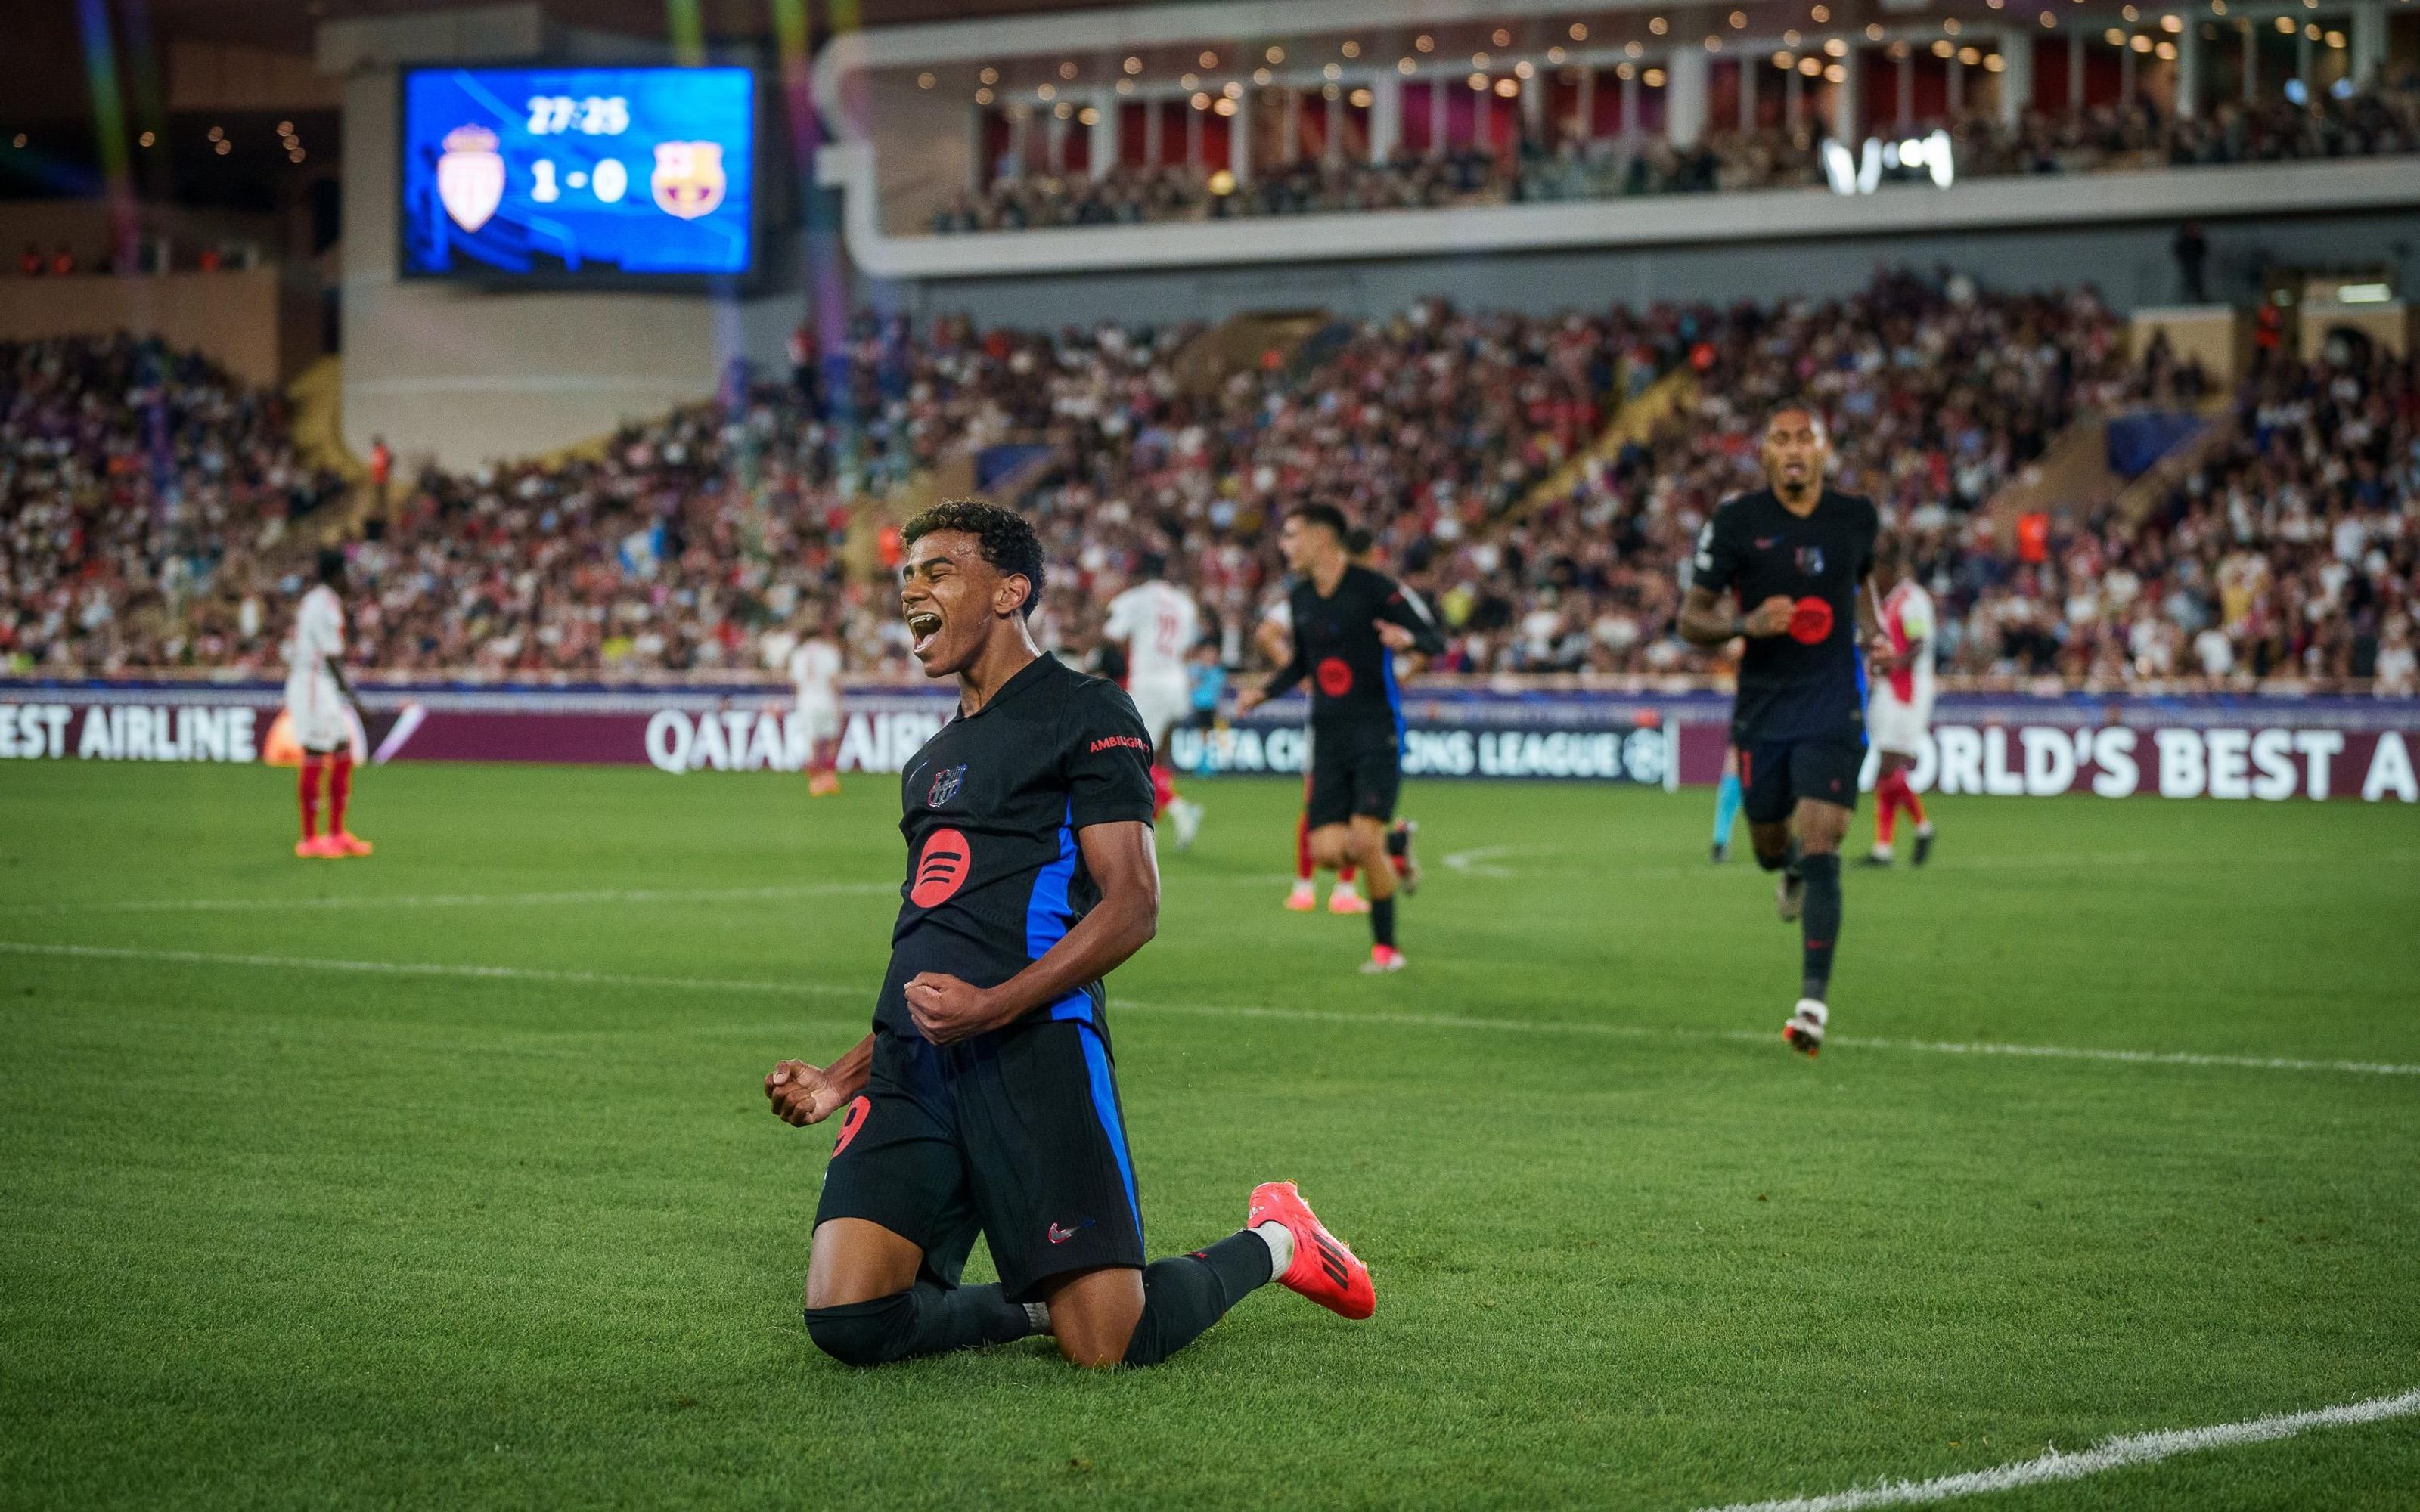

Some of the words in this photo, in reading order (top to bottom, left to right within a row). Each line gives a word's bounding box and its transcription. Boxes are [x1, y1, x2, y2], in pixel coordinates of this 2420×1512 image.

[78, 704, 256, 762] AIRLINE
[1478, 730, 1621, 777] LEAGUE
[2154, 727, 2344, 801] BEST
